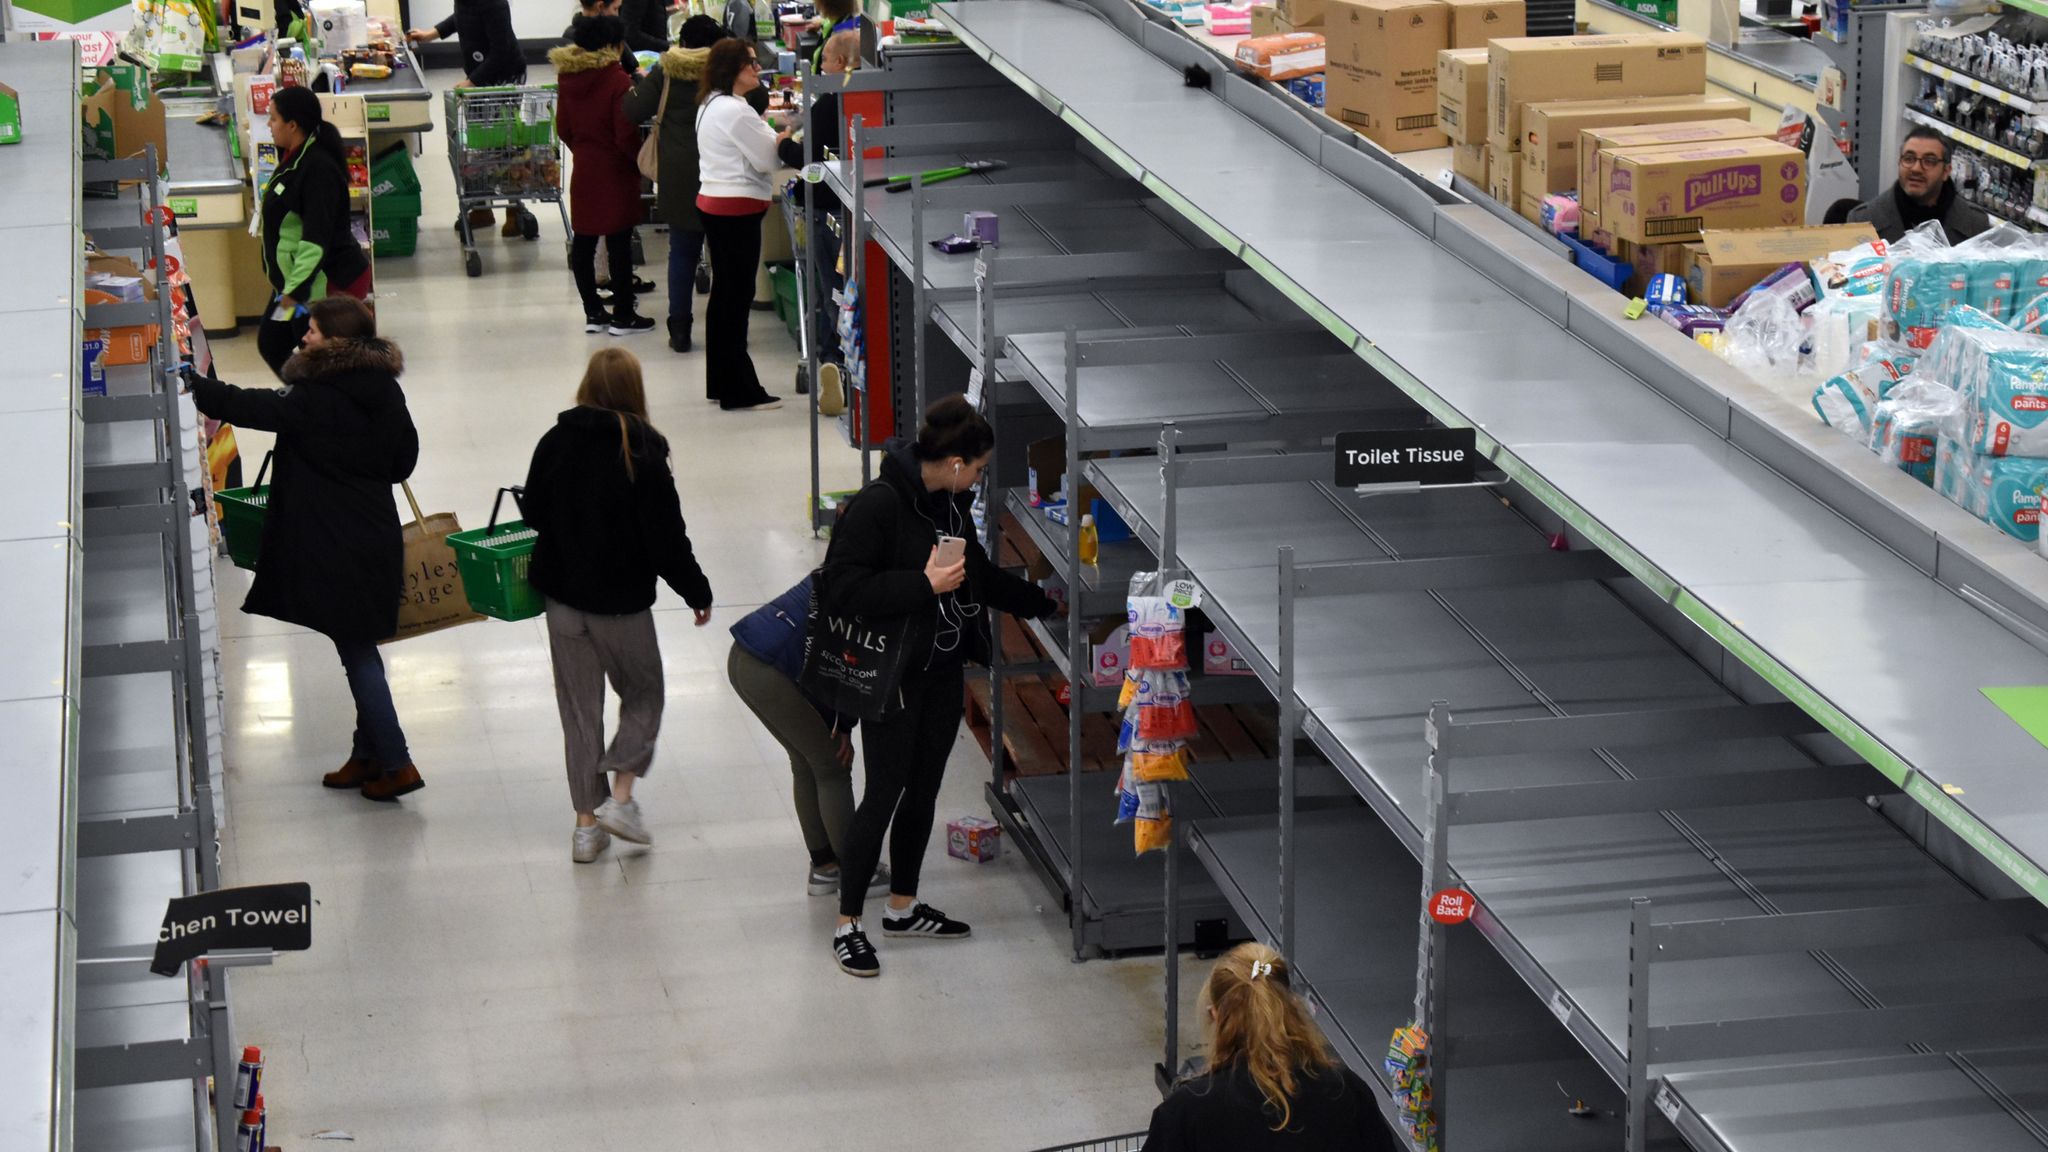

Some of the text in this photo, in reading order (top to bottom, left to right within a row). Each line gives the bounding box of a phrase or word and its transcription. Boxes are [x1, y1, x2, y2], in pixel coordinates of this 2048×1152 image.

[905, 10, 928, 19] ASDA
[1636, 3, 1658, 13] ASDA
[2010, 375, 2048, 393] Pamper
[2014, 399, 2047, 409] pants
[1345, 447, 1465, 465] Toilet Tissue
[2012, 489, 2041, 506] Pamp
[409, 561, 458, 590] yley
[1175, 581, 1195, 591] LOW
[1441, 895, 1463, 906] Roll
[225, 904, 307, 927] Towel
[1437, 904, 1464, 917] Back
